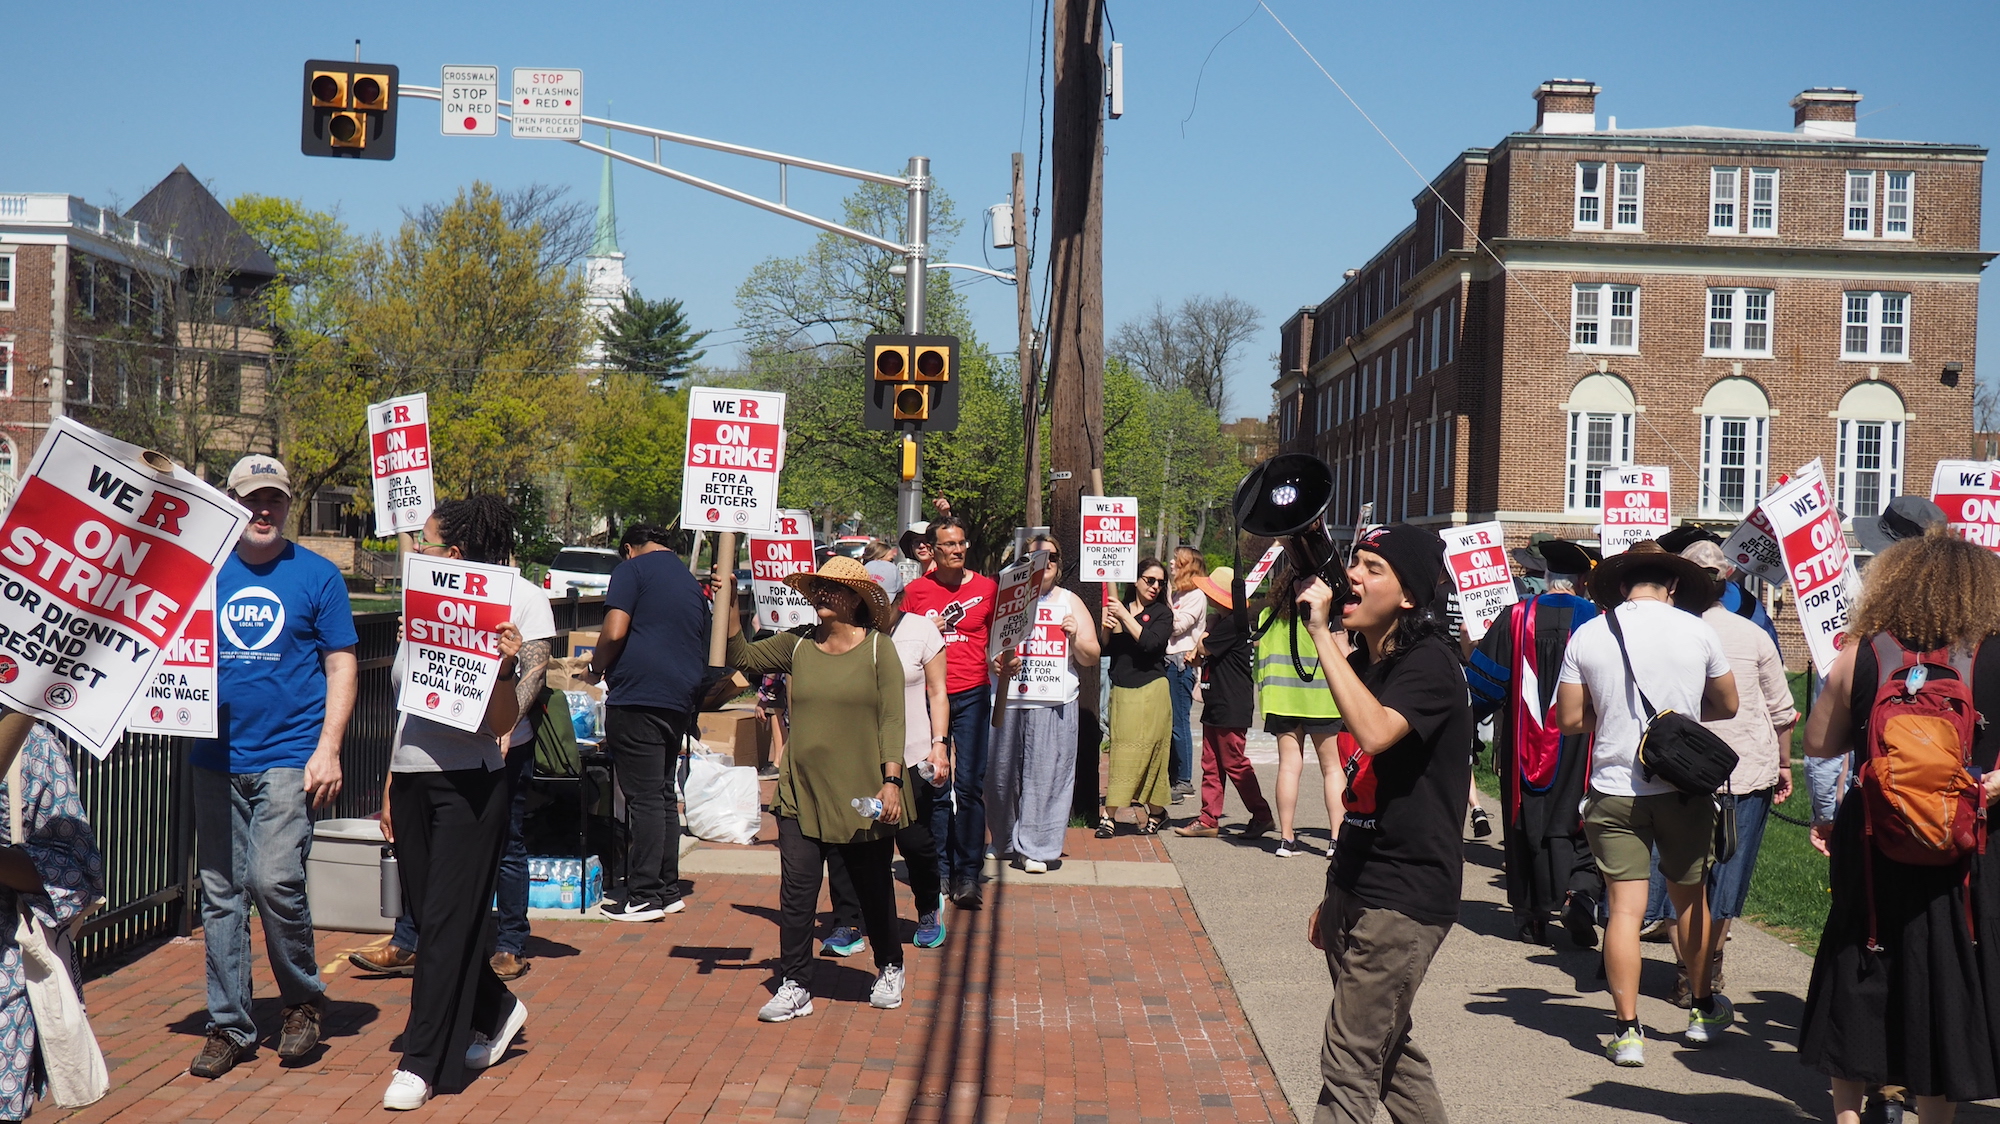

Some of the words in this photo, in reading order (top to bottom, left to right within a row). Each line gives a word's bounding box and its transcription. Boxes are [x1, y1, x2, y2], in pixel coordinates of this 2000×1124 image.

[444, 72, 495, 81] CROSSWALK
[533, 74, 563, 84] STOP
[452, 88, 488, 100] STOP
[515, 87, 528, 95] ON
[532, 88, 579, 96] FLASHING
[448, 104, 462, 113] ON
[469, 104, 492, 113] RED
[536, 99, 559, 108] RED
[382, 411, 392, 426] WE
[394, 406, 411, 423] R
[712, 400, 735, 414] WE
[738, 399, 759, 419] R
[387, 430, 406, 452] ON
[716, 424, 750, 445] ON
[376, 447, 427, 475] STRIKE
[692, 443, 773, 469] STRIKE
[390, 477, 402, 488] FOR
[405, 476, 412, 485] A
[712, 473, 736, 483] FOR
[739, 475, 748, 484] A
[1620, 474, 1638, 484] WE
[1641, 472, 1655, 486] R
[1960, 472, 1985, 486] WE
[388, 486, 417, 500] BETTER
[705, 484, 754, 497] BETTER
[88, 464, 144, 513] WE
[137, 490, 190, 536] R
[387, 496, 421, 511] RUTGERS
[700, 494, 757, 508] RUTGERS
[1112, 503, 1124, 513] R
[1624, 493, 1650, 507] ON
[1790, 492, 1817, 518] WE
[1606, 508, 1666, 523] STRIKE
[1962, 498, 2000, 523] ON
[782, 518, 798, 534] R
[1099, 517, 1120, 530] ON
[1085, 530, 1134, 543] STRIKE
[1459, 535, 1477, 546] WE
[1476, 531, 1491, 545] R
[1811, 514, 1837, 550] ON
[1949, 522, 2000, 547] TRI
[74, 520, 151, 576] ON
[1758, 534, 1778, 550] FOR
[767, 543, 792, 560] ON
[1470, 550, 1492, 568] ON
[1739, 542, 1781, 567] RUTGERS
[754, 560, 811, 578] STRIKE
[1013, 570, 1028, 582] WE
[1459, 564, 1508, 588] STRIKE
[2, 526, 180, 638] STRIKE
[432, 571, 460, 590] WE
[463, 572, 488, 597] R
[770, 586, 786, 596] FOR
[790, 587, 797, 595] A
[1465, 592, 1482, 602] FOR
[759, 596, 784, 606] LIVING
[1486, 596, 1501, 607] AND
[1804, 590, 1830, 612] FOR
[228, 605, 274, 622] URA
[438, 600, 476, 627] ON
[1039, 609, 1052, 621] R
[1476, 606, 1504, 618] RESPE
[28, 622, 86, 657] AND
[41, 601, 150, 663] DIGNITY
[411, 618, 500, 656] STRIKE
[165, 638, 210, 663] IKE
[1019, 640, 1064, 655] TRIKE
[0, 624, 107, 689] RESPECT
[420, 648, 446, 663] FOR
[450, 654, 487, 675] EQUAL
[179, 674, 188, 686] A
[428, 663, 452, 676] PAY
[455, 670, 477, 686] FOR
[146, 686, 171, 699] ING
[175, 688, 210, 701] WAGE
[412, 672, 451, 692] EQUAL
[454, 683, 484, 701] WORK
